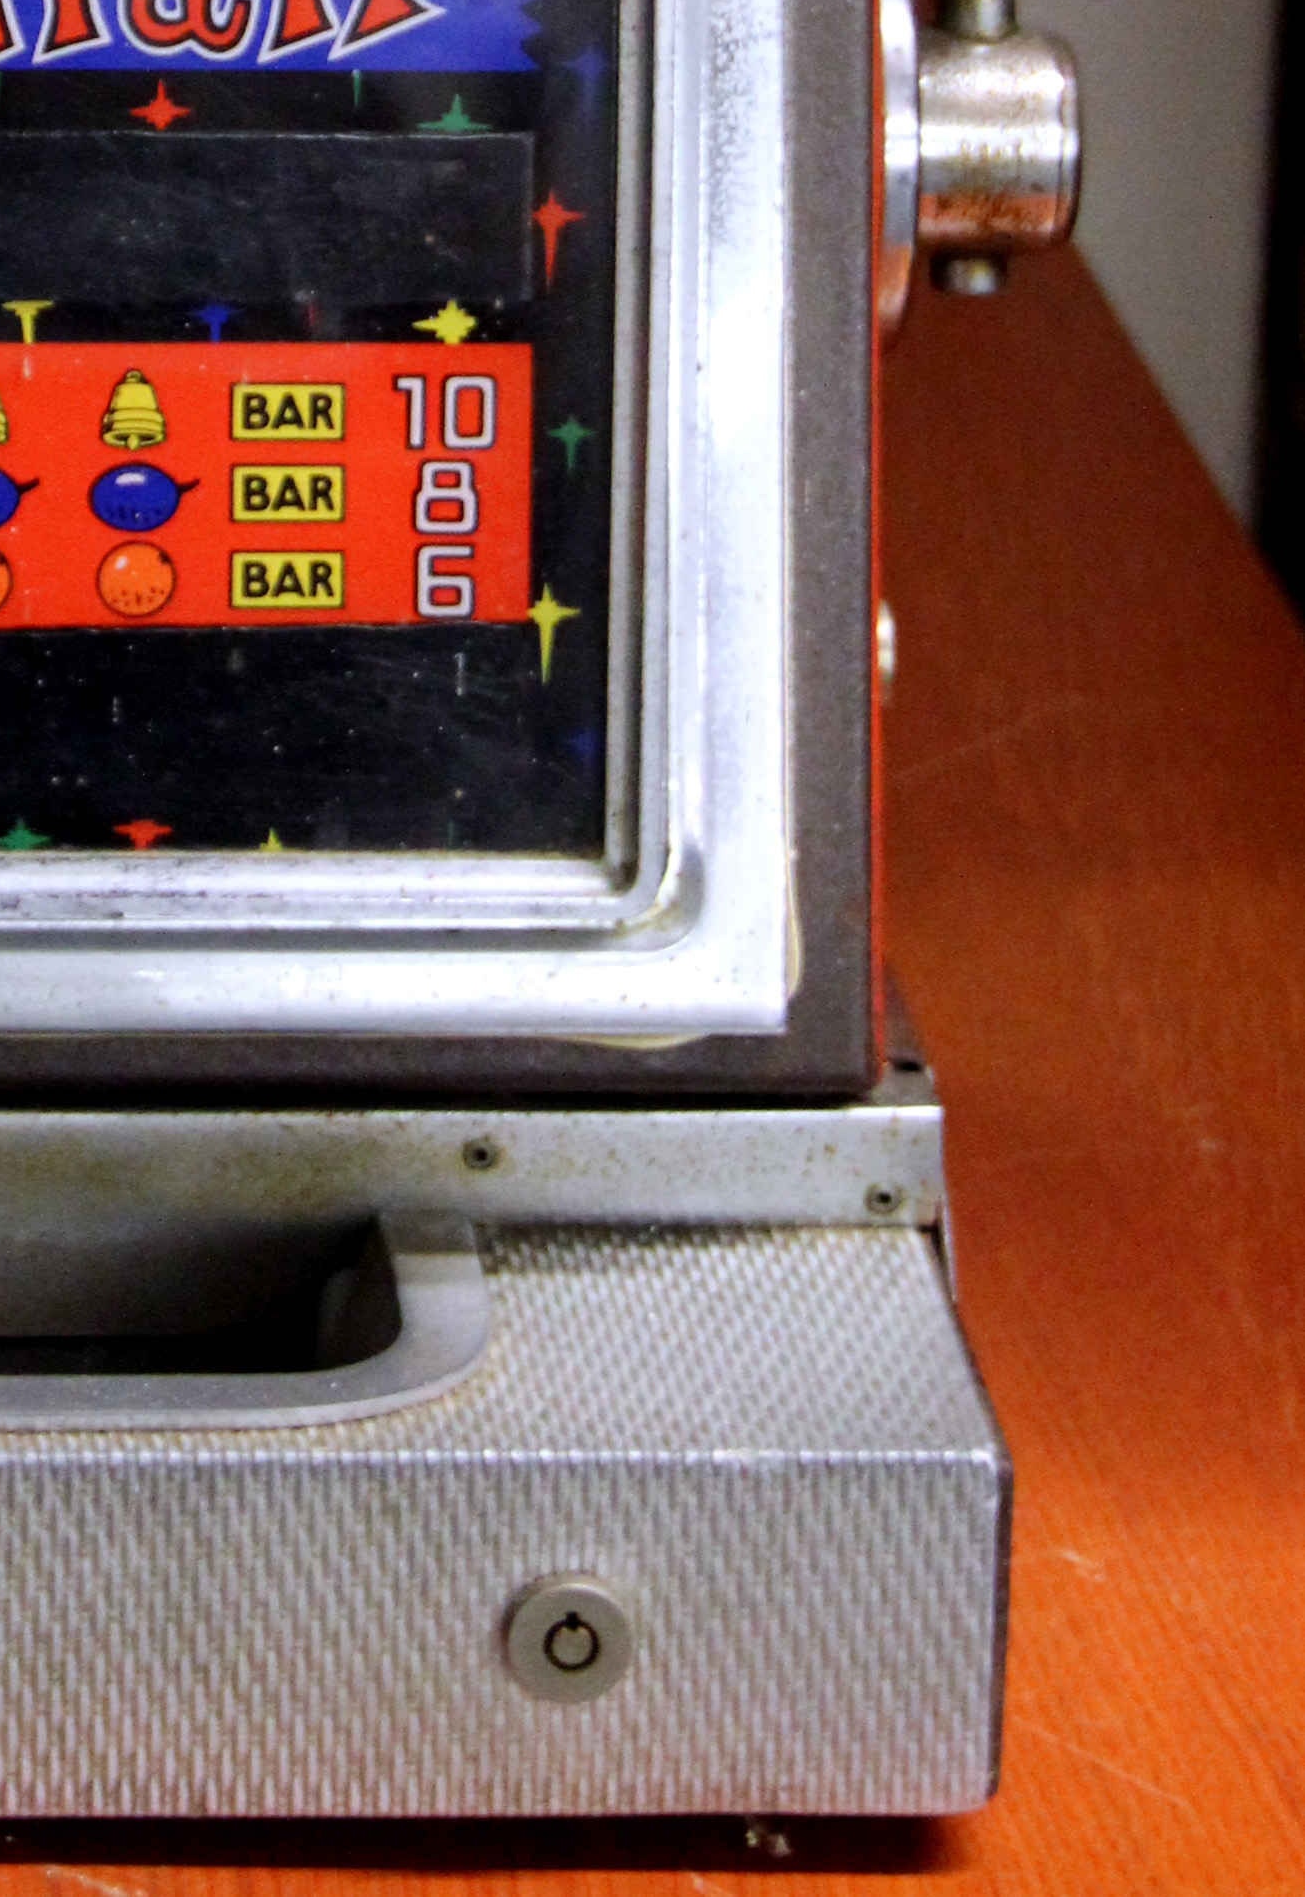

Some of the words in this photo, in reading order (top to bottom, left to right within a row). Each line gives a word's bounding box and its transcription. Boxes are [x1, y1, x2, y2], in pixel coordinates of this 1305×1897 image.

[242, 395, 333, 430] BAR
[394, 375, 496, 450] 10
[241, 476, 333, 512] BAR
[414, 460, 478, 535] 8
[240, 563, 334, 599] BAR
[415, 545, 476, 619] 6
